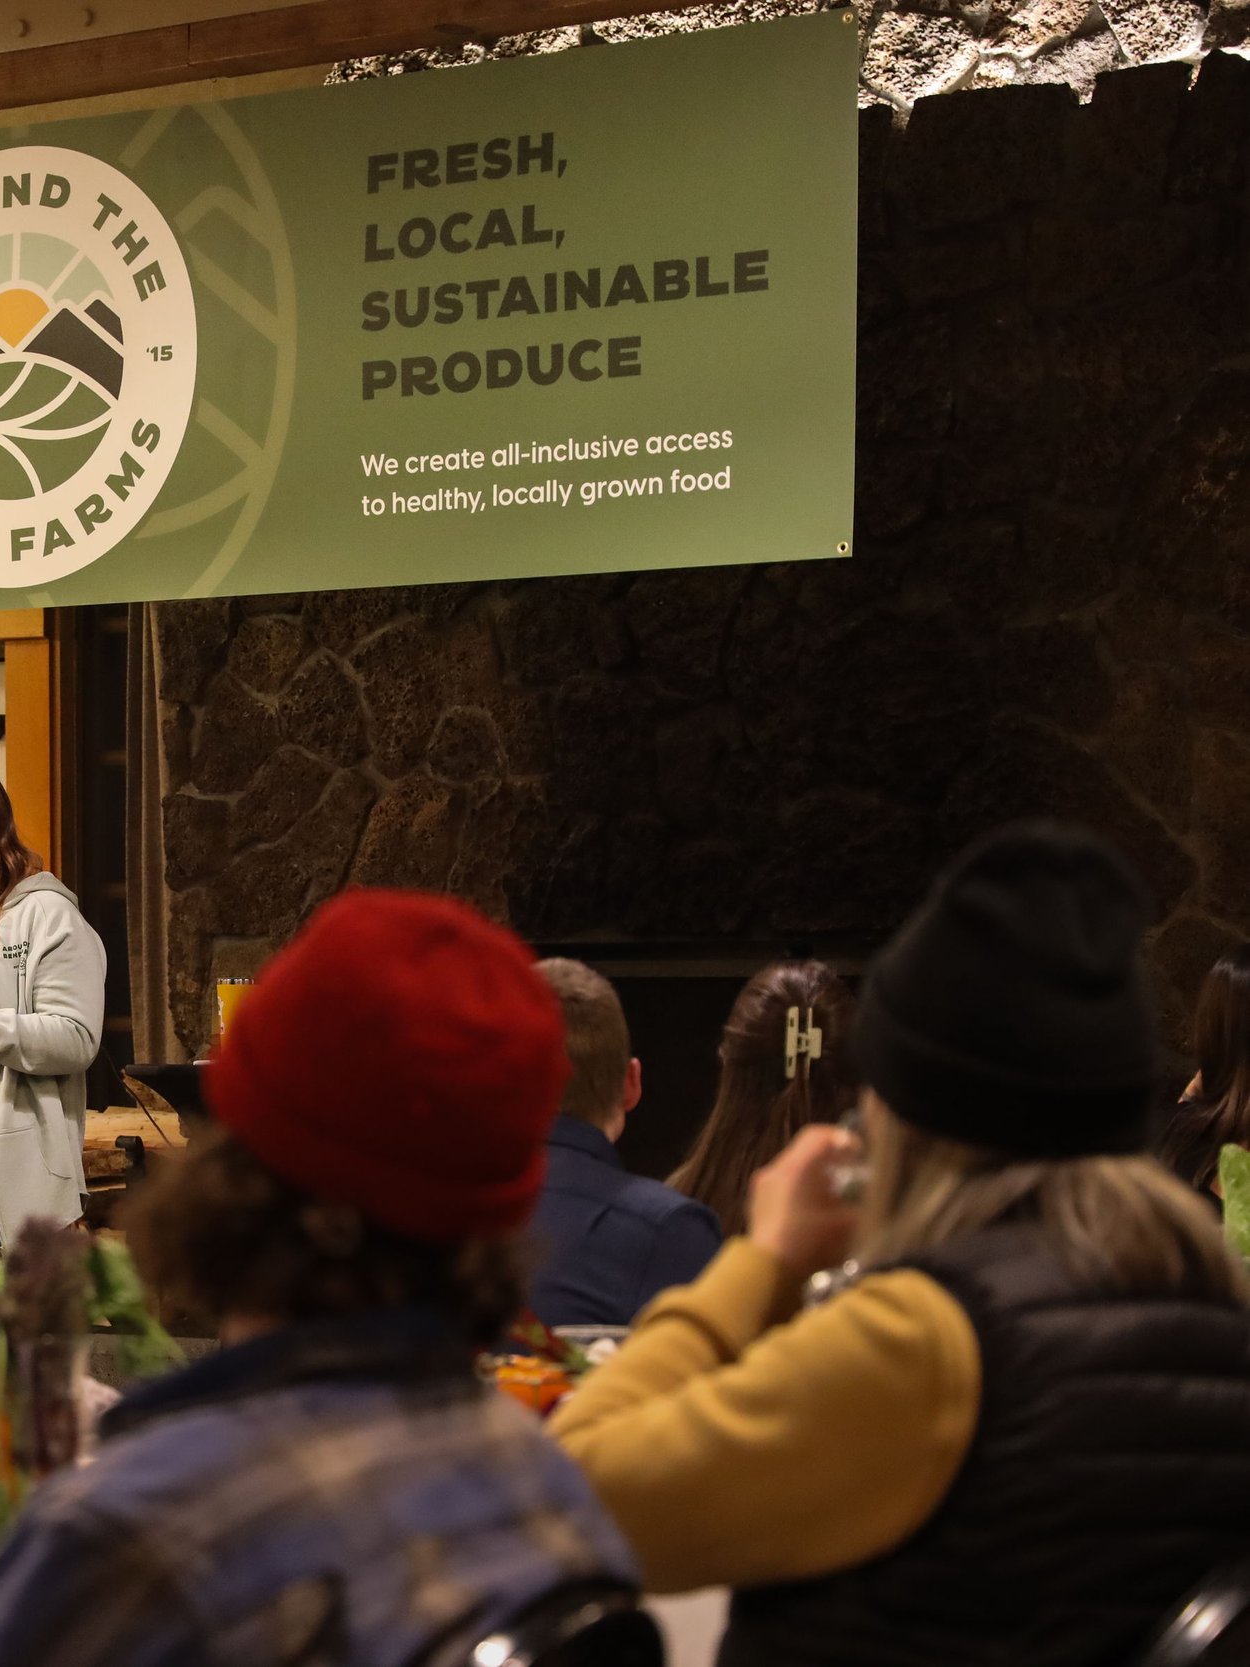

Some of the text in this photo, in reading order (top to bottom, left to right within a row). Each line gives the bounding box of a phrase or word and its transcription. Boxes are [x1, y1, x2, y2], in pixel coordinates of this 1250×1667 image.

[366, 131, 568, 195] FRESH,
[92, 192, 167, 303] THE
[364, 203, 566, 263] LOCAL,
[361, 249, 770, 332] SUSTAINABLE
[362, 335, 642, 401] PRODUCE
[360, 430, 734, 477] We create all-inclusive access
[10, 418, 162, 562] FARMS
[361, 465, 732, 516] to healthy, locally grown food
